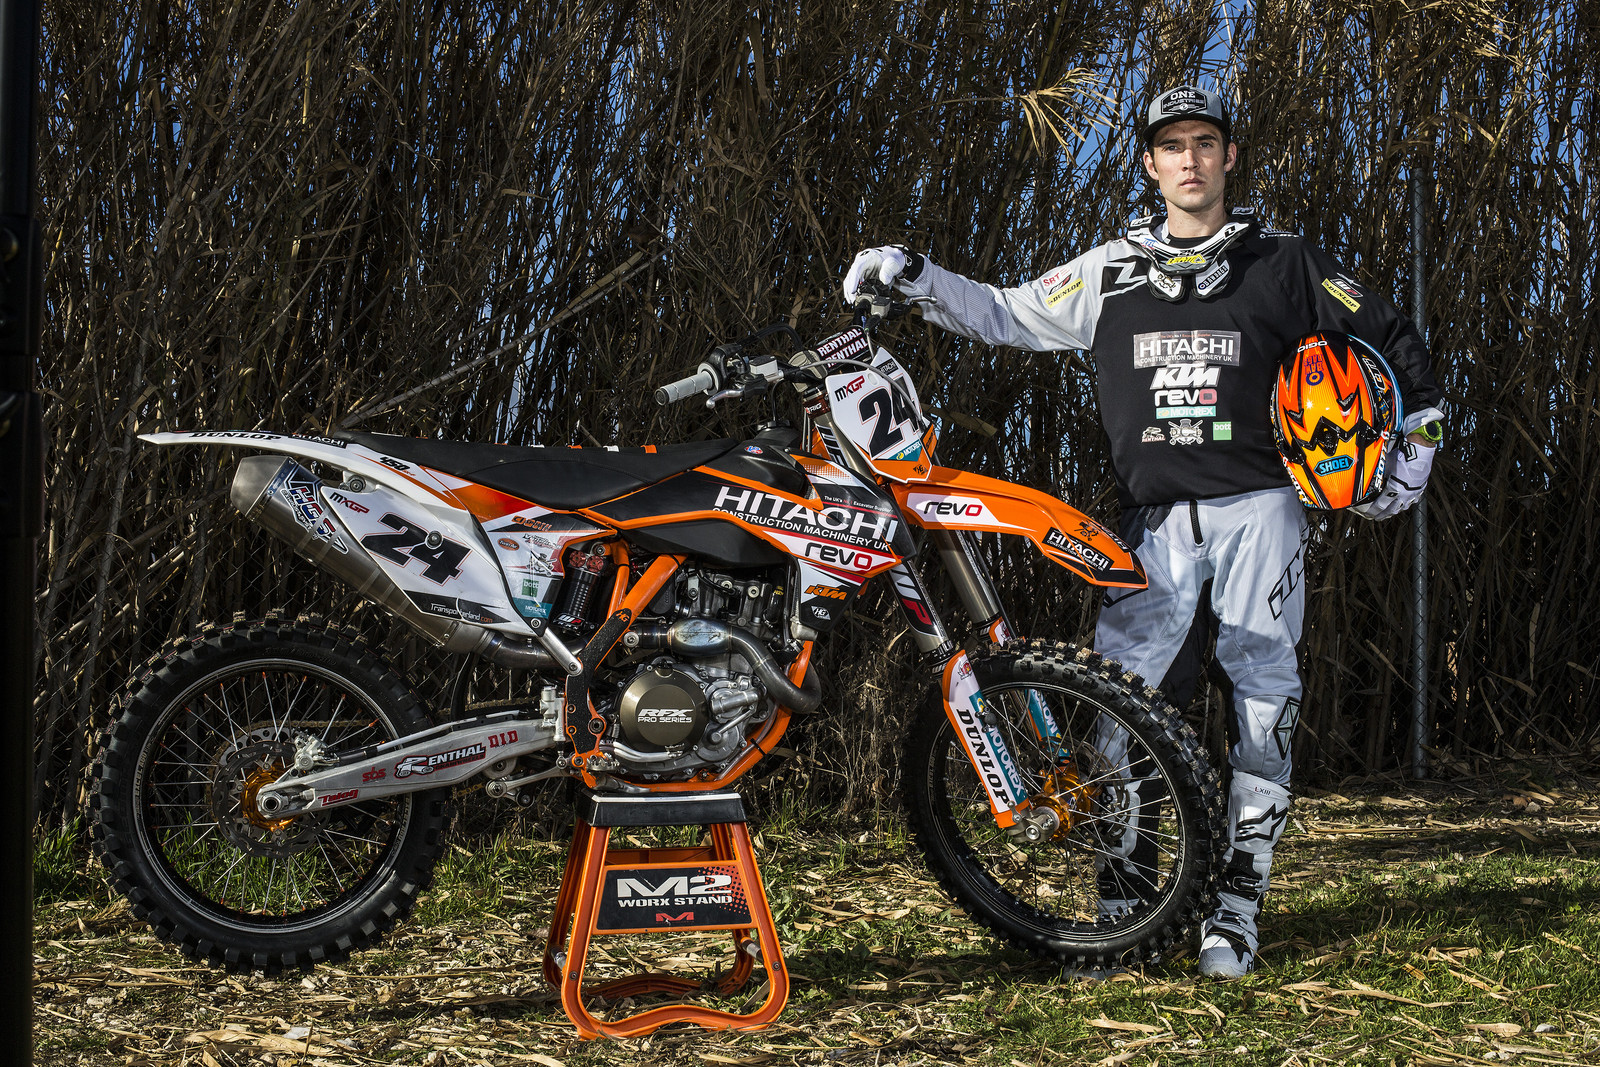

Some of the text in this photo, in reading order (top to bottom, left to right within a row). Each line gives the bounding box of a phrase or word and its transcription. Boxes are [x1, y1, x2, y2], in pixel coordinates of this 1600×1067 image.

[1171, 91, 1196, 101] ONE
[1052, 280, 1082, 303] DUNLOP
[1328, 286, 1358, 308] DUNLOP
[817, 328, 862, 357] RENTHAL
[825, 337, 868, 369] RENTHAL
[1139, 337, 1234, 358] HITACHI
[1297, 341, 1328, 353] OGIO
[1140, 354, 1186, 364] CONSTRUCTION
[1187, 354, 1222, 363] MACHINERY
[1151, 362, 1221, 389] KTM
[834, 375, 865, 402] MXGP
[1154, 388, 1218, 407] revo
[859, 375, 920, 459] 24
[1170, 406, 1214, 417] MOTOREX
[189, 432, 282, 441] DUNLOP
[380, 456, 410, 471] 450
[1319, 458, 1350, 474] SHOEI
[330, 491, 370, 514] MXGP
[924, 502, 983, 517] revo
[714, 486, 898, 543] HITACHI
[361, 513, 471, 585] 24
[803, 525, 871, 548] MACHINERY
[873, 541, 891, 552] UK
[804, 542, 873, 571] revo
[1048, 532, 1109, 569] HITACHI
[804, 584, 848, 600] KTM
[639, 708, 694, 717] RFX
[488, 731, 519, 748] DID
[395, 744, 485, 778] RENTHAL
[956, 708, 1008, 804] DUNLOP
[987, 723, 1025, 796] MOTOREX
[362, 766, 387, 783] sbs
[617, 875, 733, 898] M2
[618, 894, 733, 908] WORX STAND
